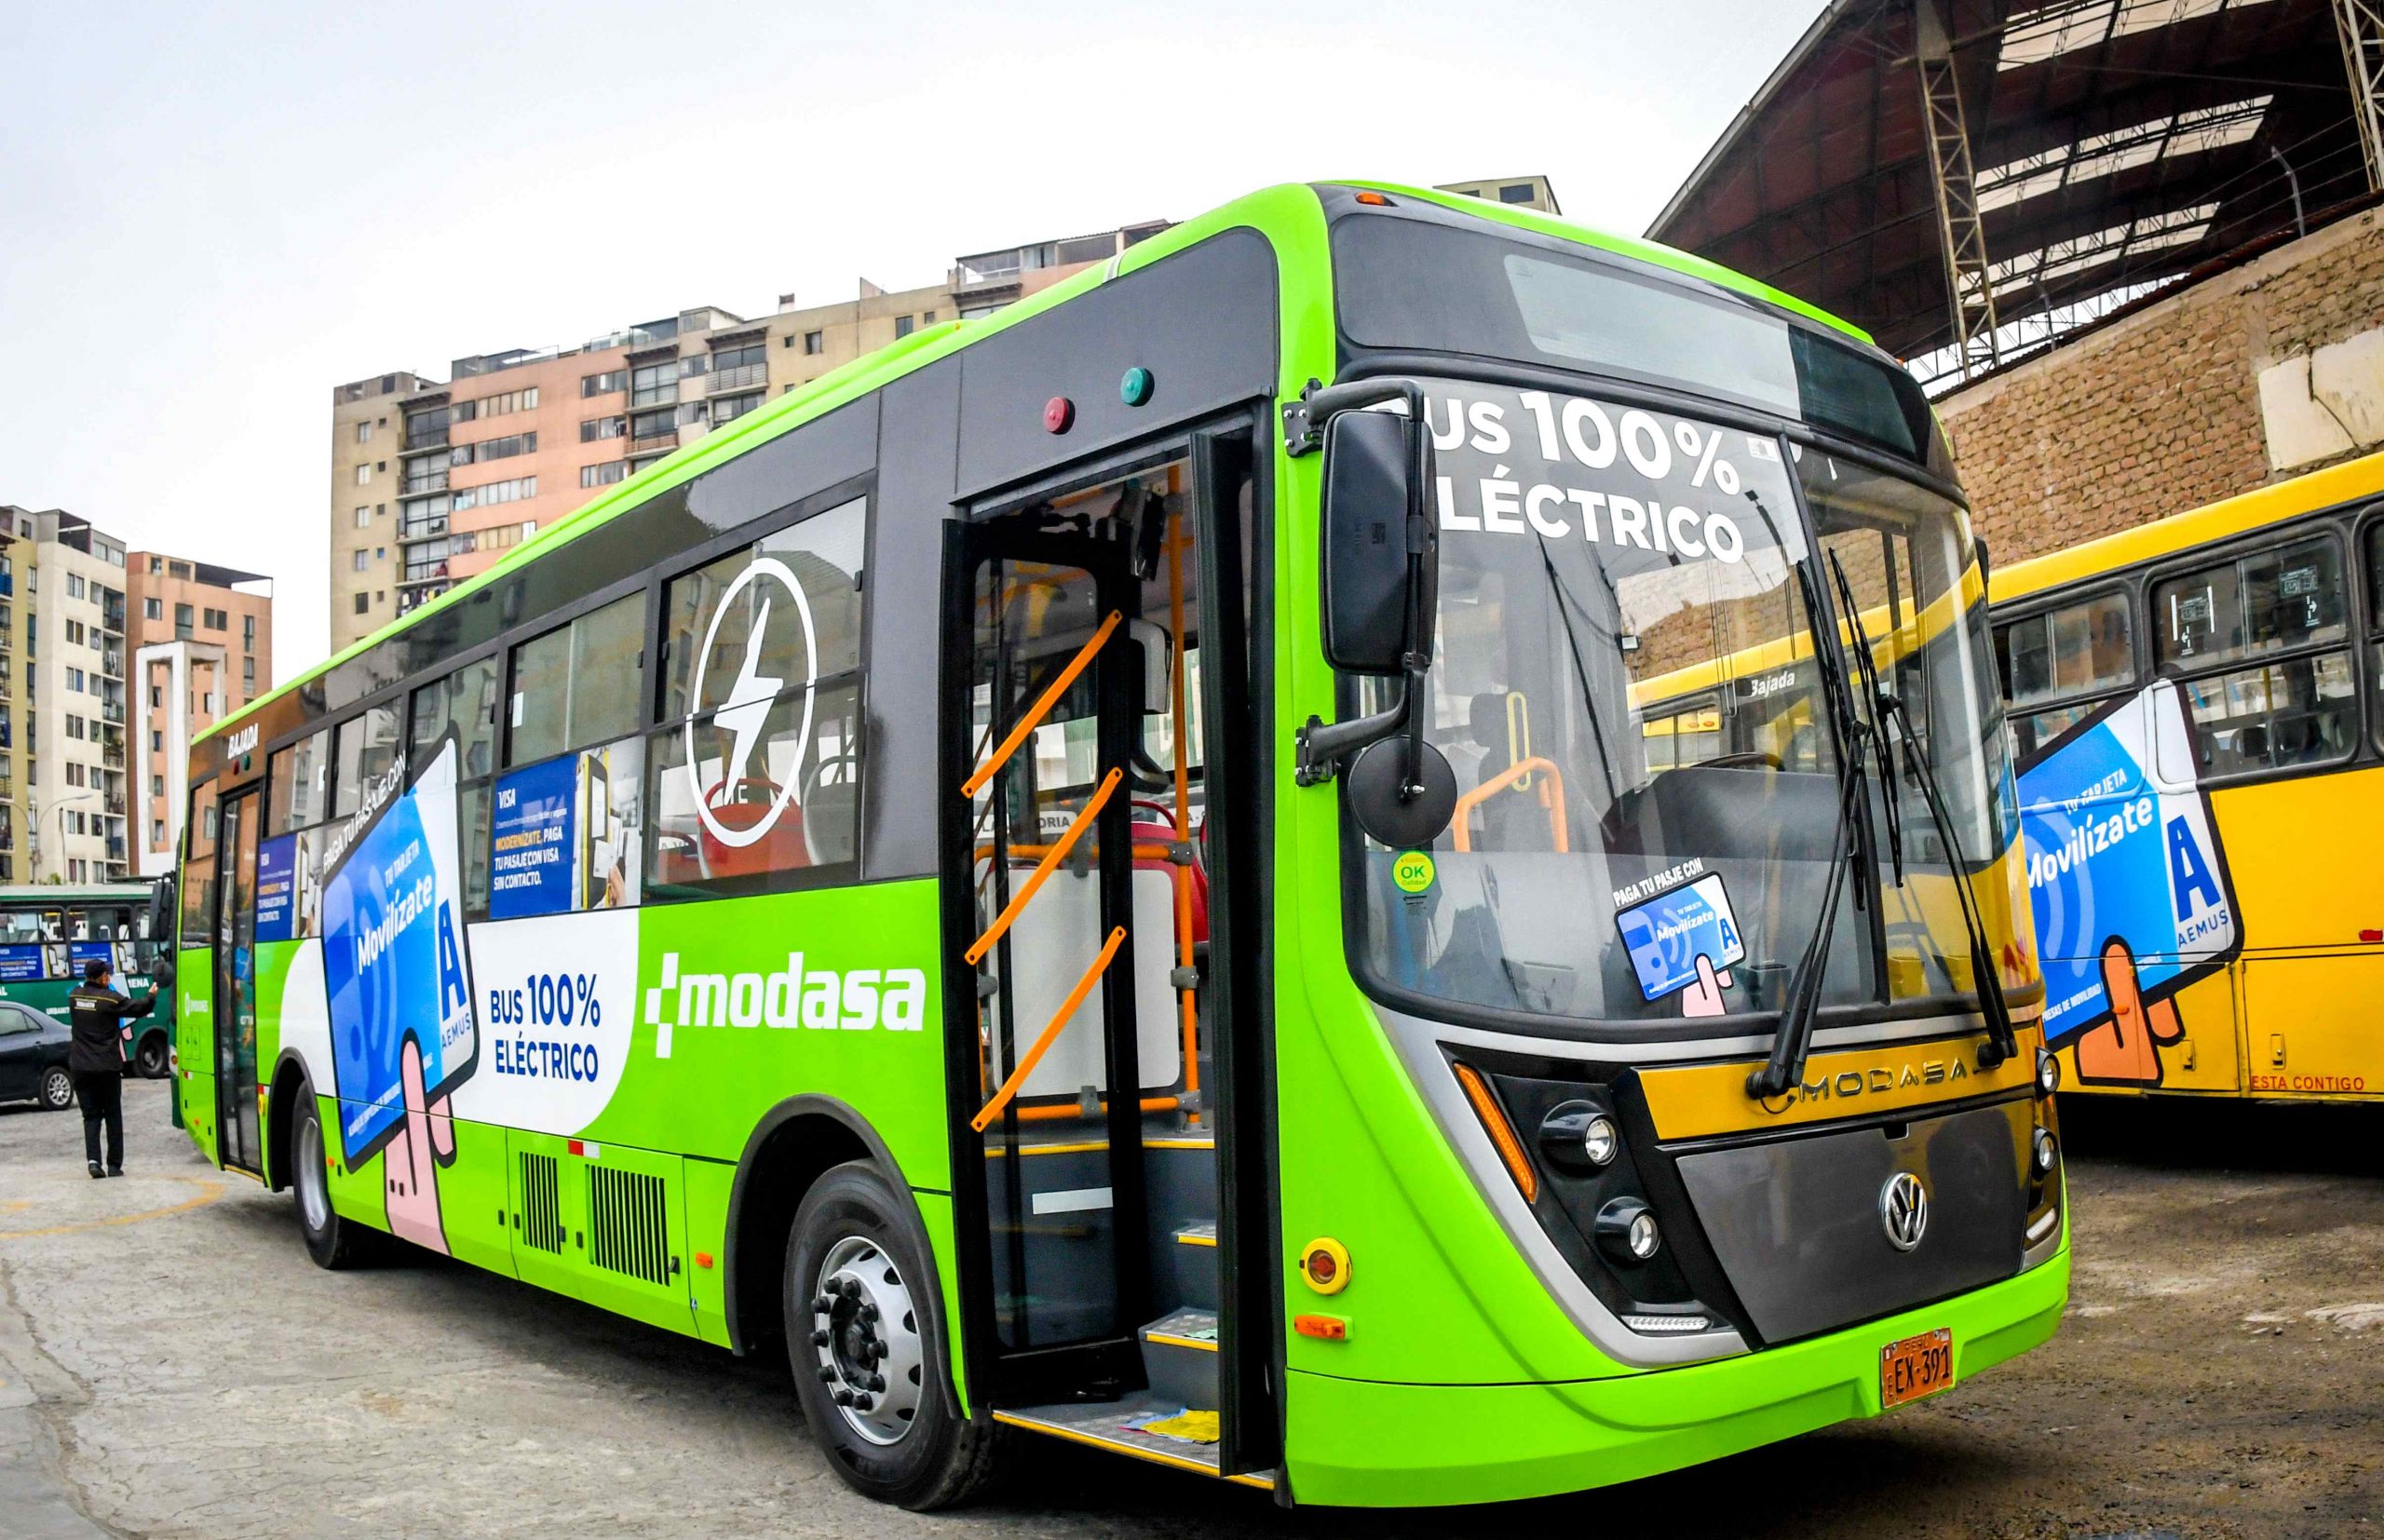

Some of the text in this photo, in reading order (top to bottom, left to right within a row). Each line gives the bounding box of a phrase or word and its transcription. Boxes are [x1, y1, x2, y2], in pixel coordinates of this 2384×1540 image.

[1423, 390, 1741, 496] US 100%
[1436, 465, 1744, 564] LÉCTRICO
[227, 723, 259, 760] BAJADA
[323, 834, 345, 874] PAGA
[343, 817, 355, 848] TU
[387, 749, 407, 791] CON
[498, 788, 516, 809] VISA
[544, 826, 562, 843] PAGA
[1039, 814, 1070, 828] ORIA
[494, 846, 559, 871] TU PASAJE CON VISA
[1401, 865, 1425, 879] OK
[494, 871, 542, 891] SIN CONTACTO.
[1613, 857, 1703, 907] PAGA TU PASJE CON
[358, 873, 433, 976] Movilízate
[1657, 911, 1714, 942] Movilízate
[2178, 910, 2229, 948] AEMUS
[491, 973, 601, 1027] BUS 100%
[677, 951, 927, 1032] modasa
[441, 1012, 472, 1050] AEMUS
[494, 1031, 598, 1083] ELÉCTRICO
[1799, 1058, 1968, 1102] MODASA
[2251, 1075, 2364, 1090] ESTA CONTIGO
[1894, 1343, 1950, 1393] EX-391
